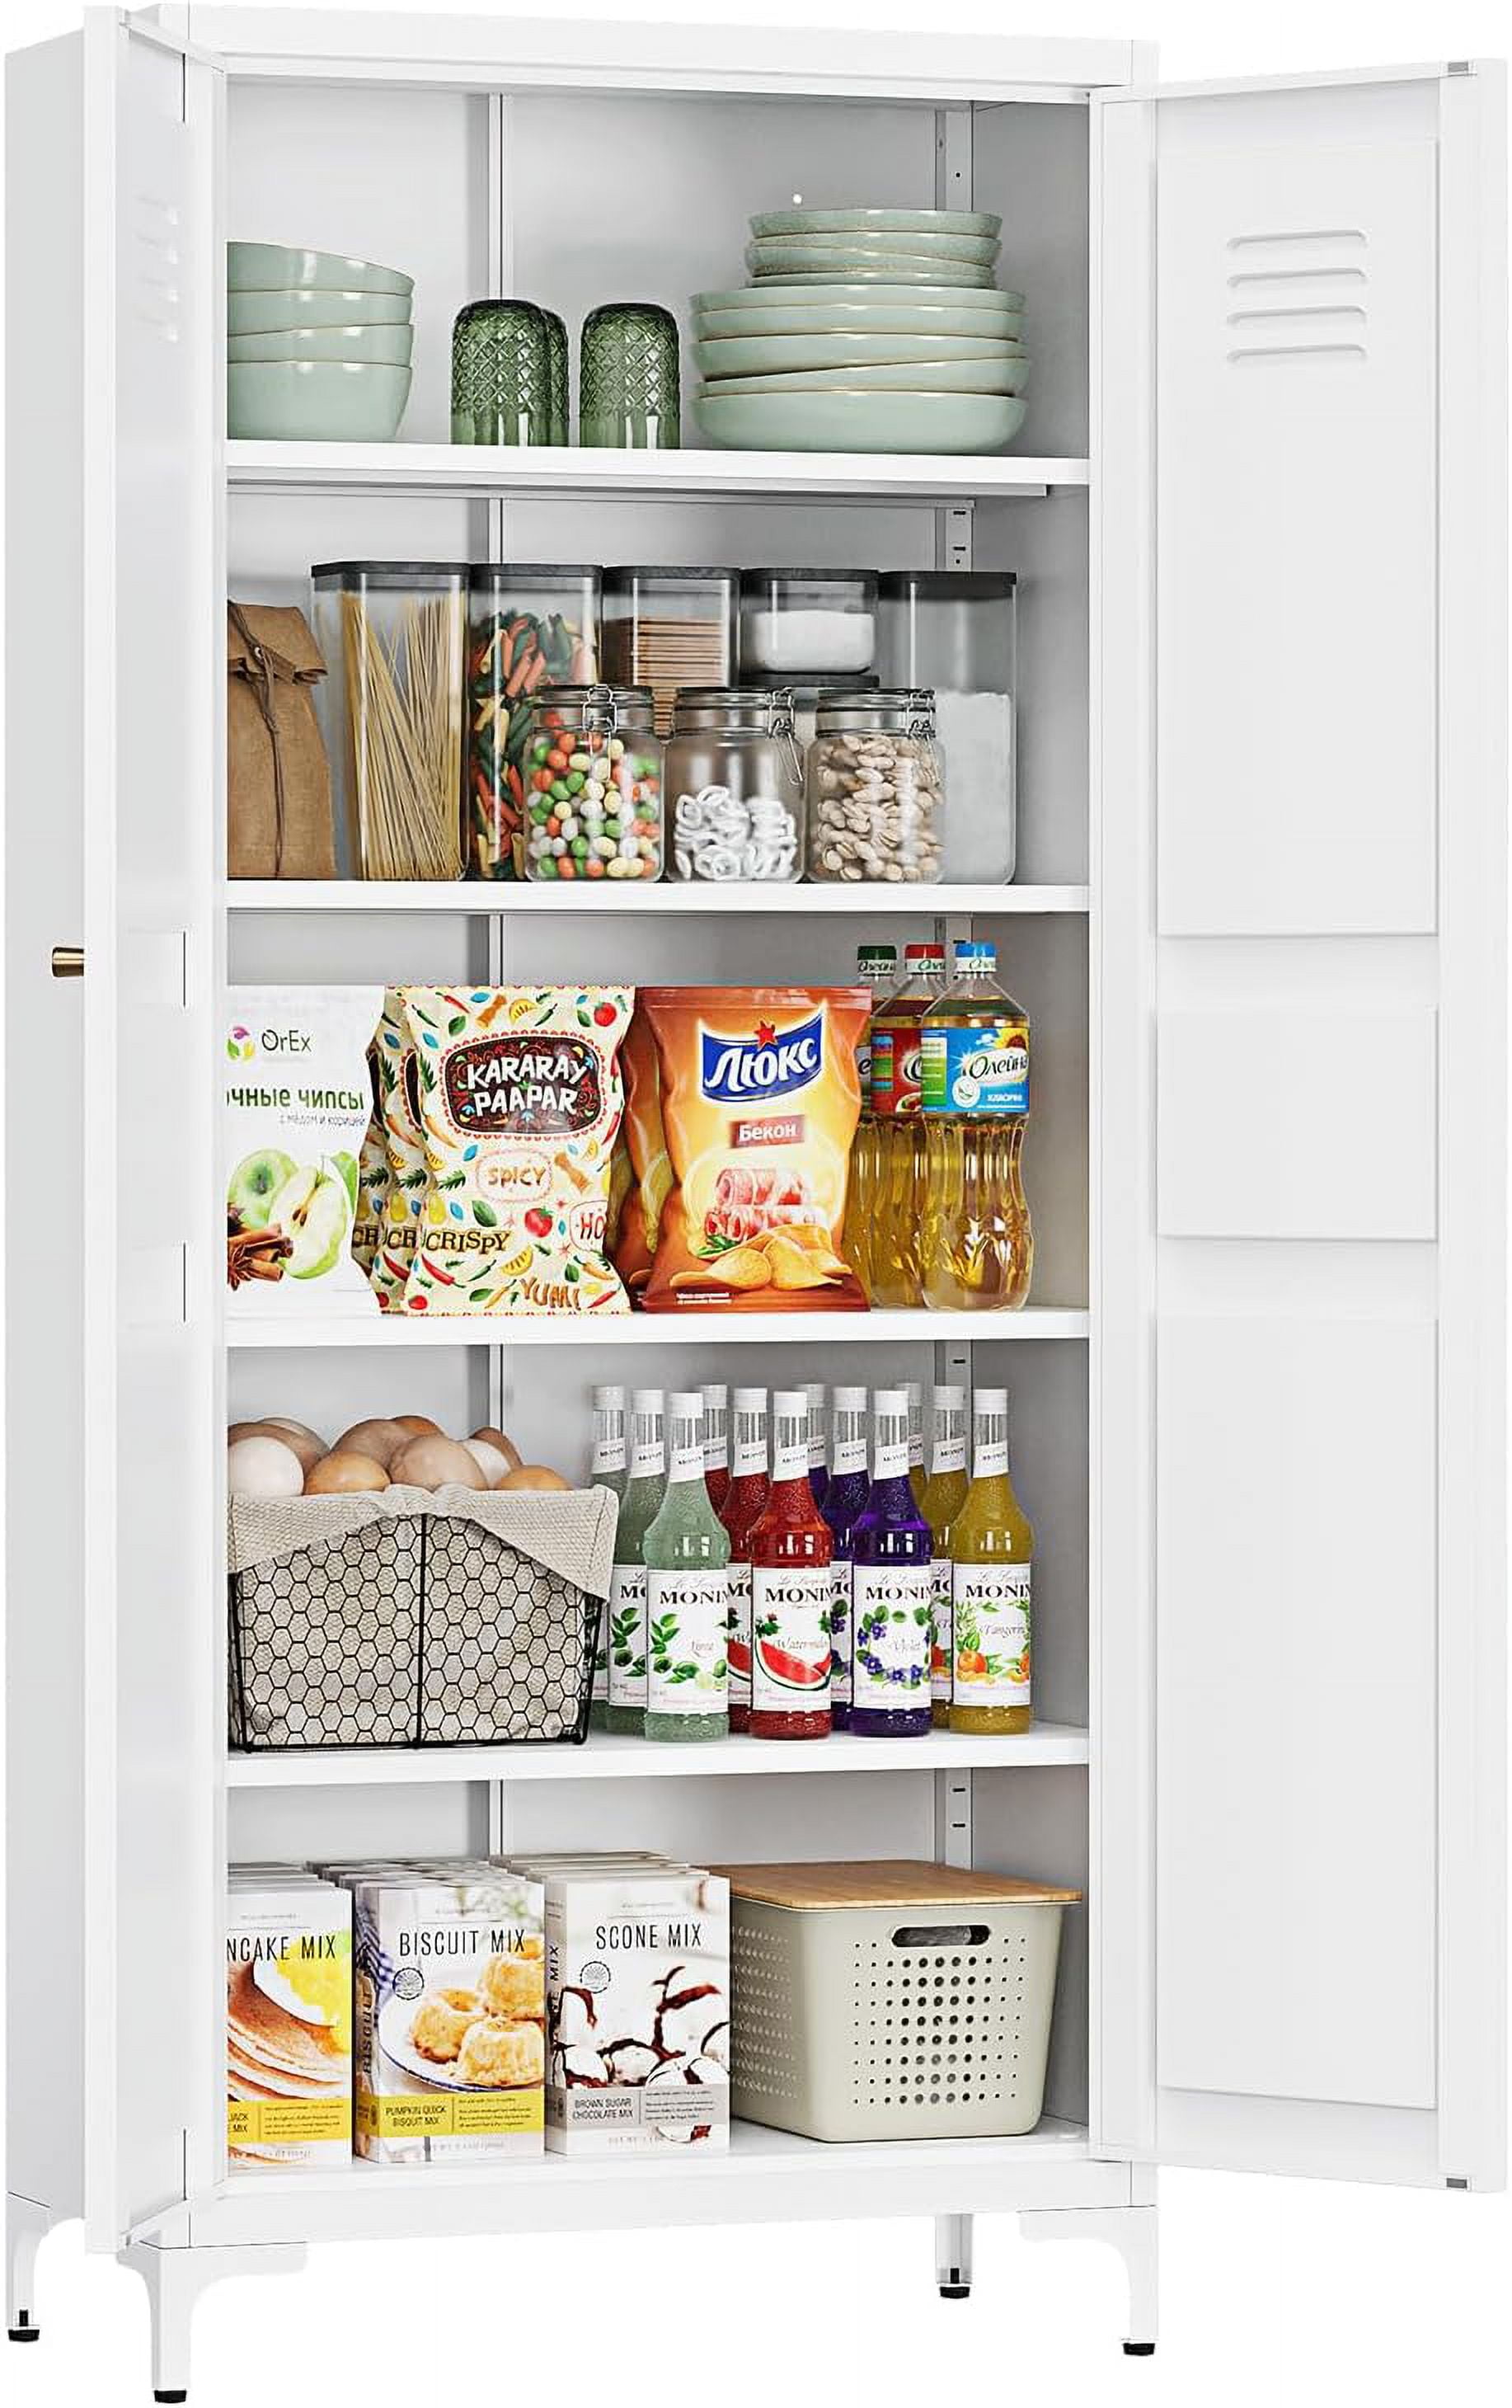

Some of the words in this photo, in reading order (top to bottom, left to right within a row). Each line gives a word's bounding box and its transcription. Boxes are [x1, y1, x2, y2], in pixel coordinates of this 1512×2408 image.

[261, 1029, 312, 1051] OrEx
[467, 1053, 588, 1090] KARARAY
[226, 1087, 291, 1108] чные
[298, 1089, 365, 1110] чипсы
[473, 1085, 578, 1117] PAAPAR
[739, 1123, 797, 1142] Бекон
[487, 1164, 547, 1188] SPICY
[425, 1230, 512, 1255] CRISPY
[227, 1936, 290, 1962] NCAKE
[302, 1935, 336, 1959] MIX
[400, 1931, 479, 1957] BISCUIT
[491, 1929, 525, 1953] MIX
[596, 1926, 659, 1949] SCONE
[669, 1924, 702, 1947] MIX
